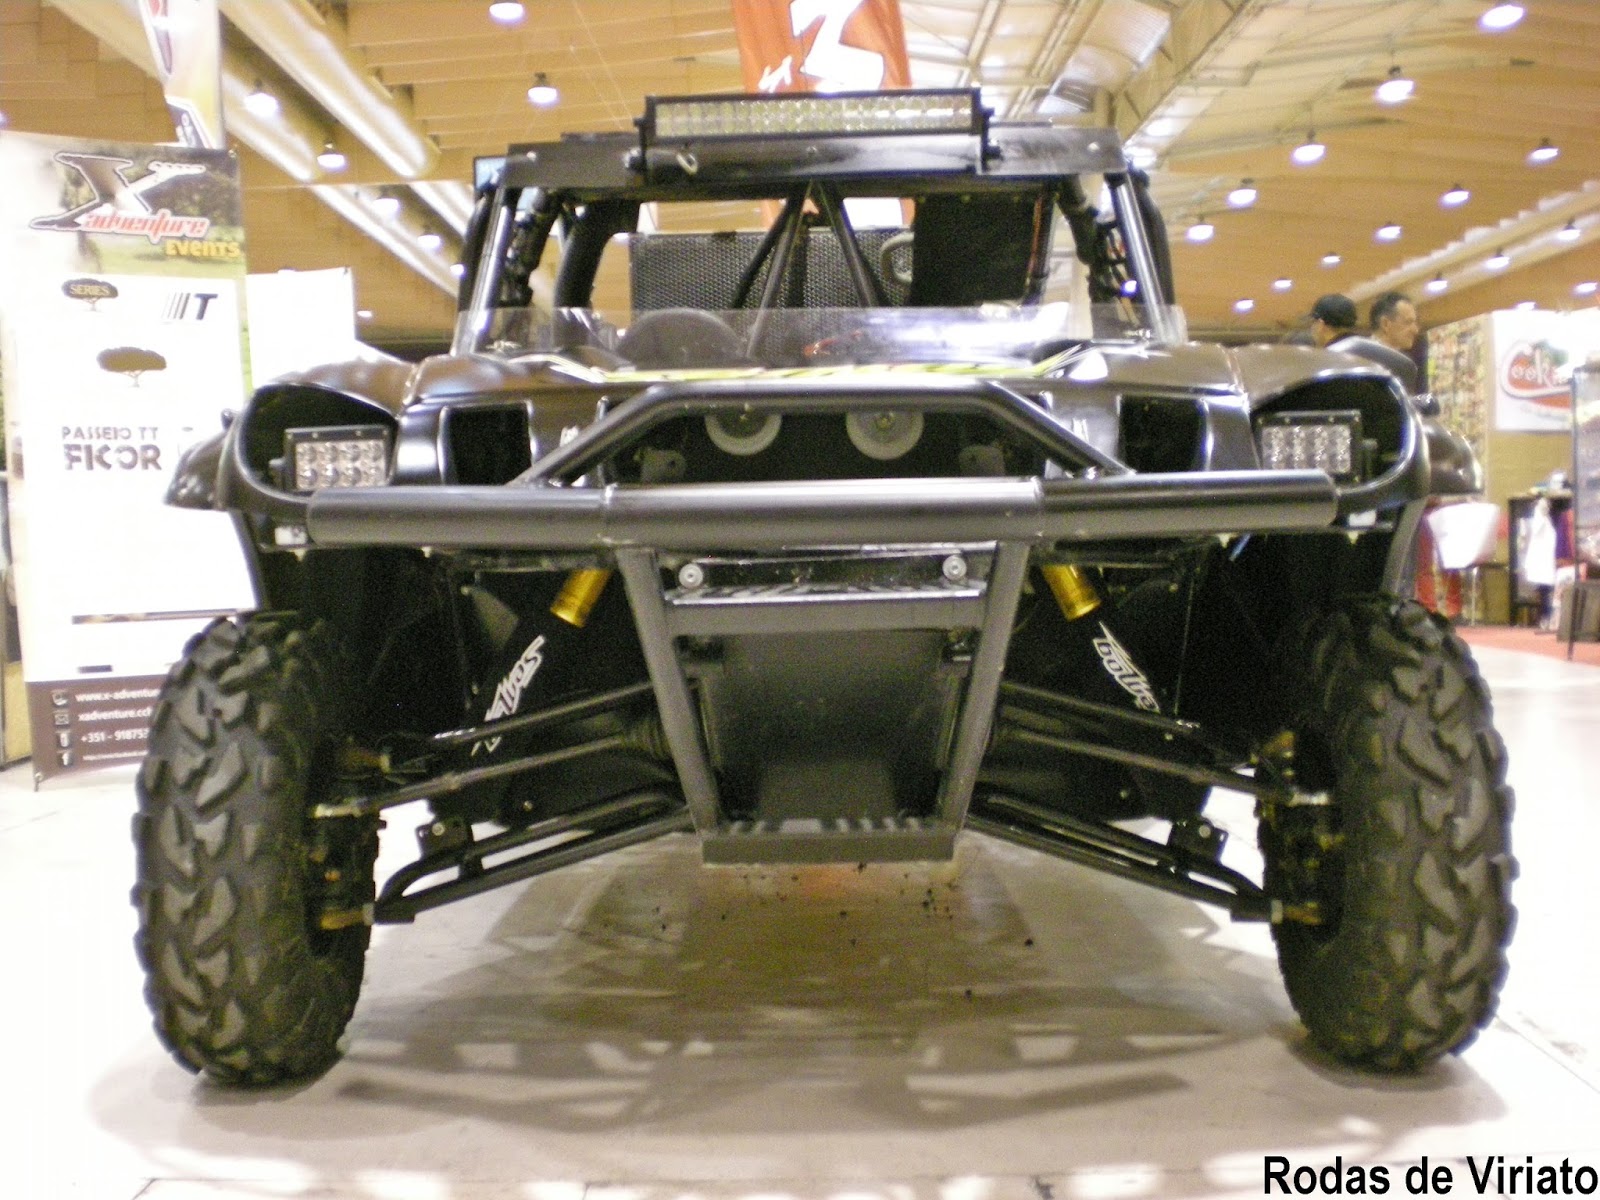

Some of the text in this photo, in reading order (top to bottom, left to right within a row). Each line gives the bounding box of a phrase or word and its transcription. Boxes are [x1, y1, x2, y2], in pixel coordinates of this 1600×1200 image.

[82, 208, 209, 242] adventure
[69, 284, 112, 296] SERIES
[138, 426, 158, 441] TT
[63, 443, 162, 471] FICOR
